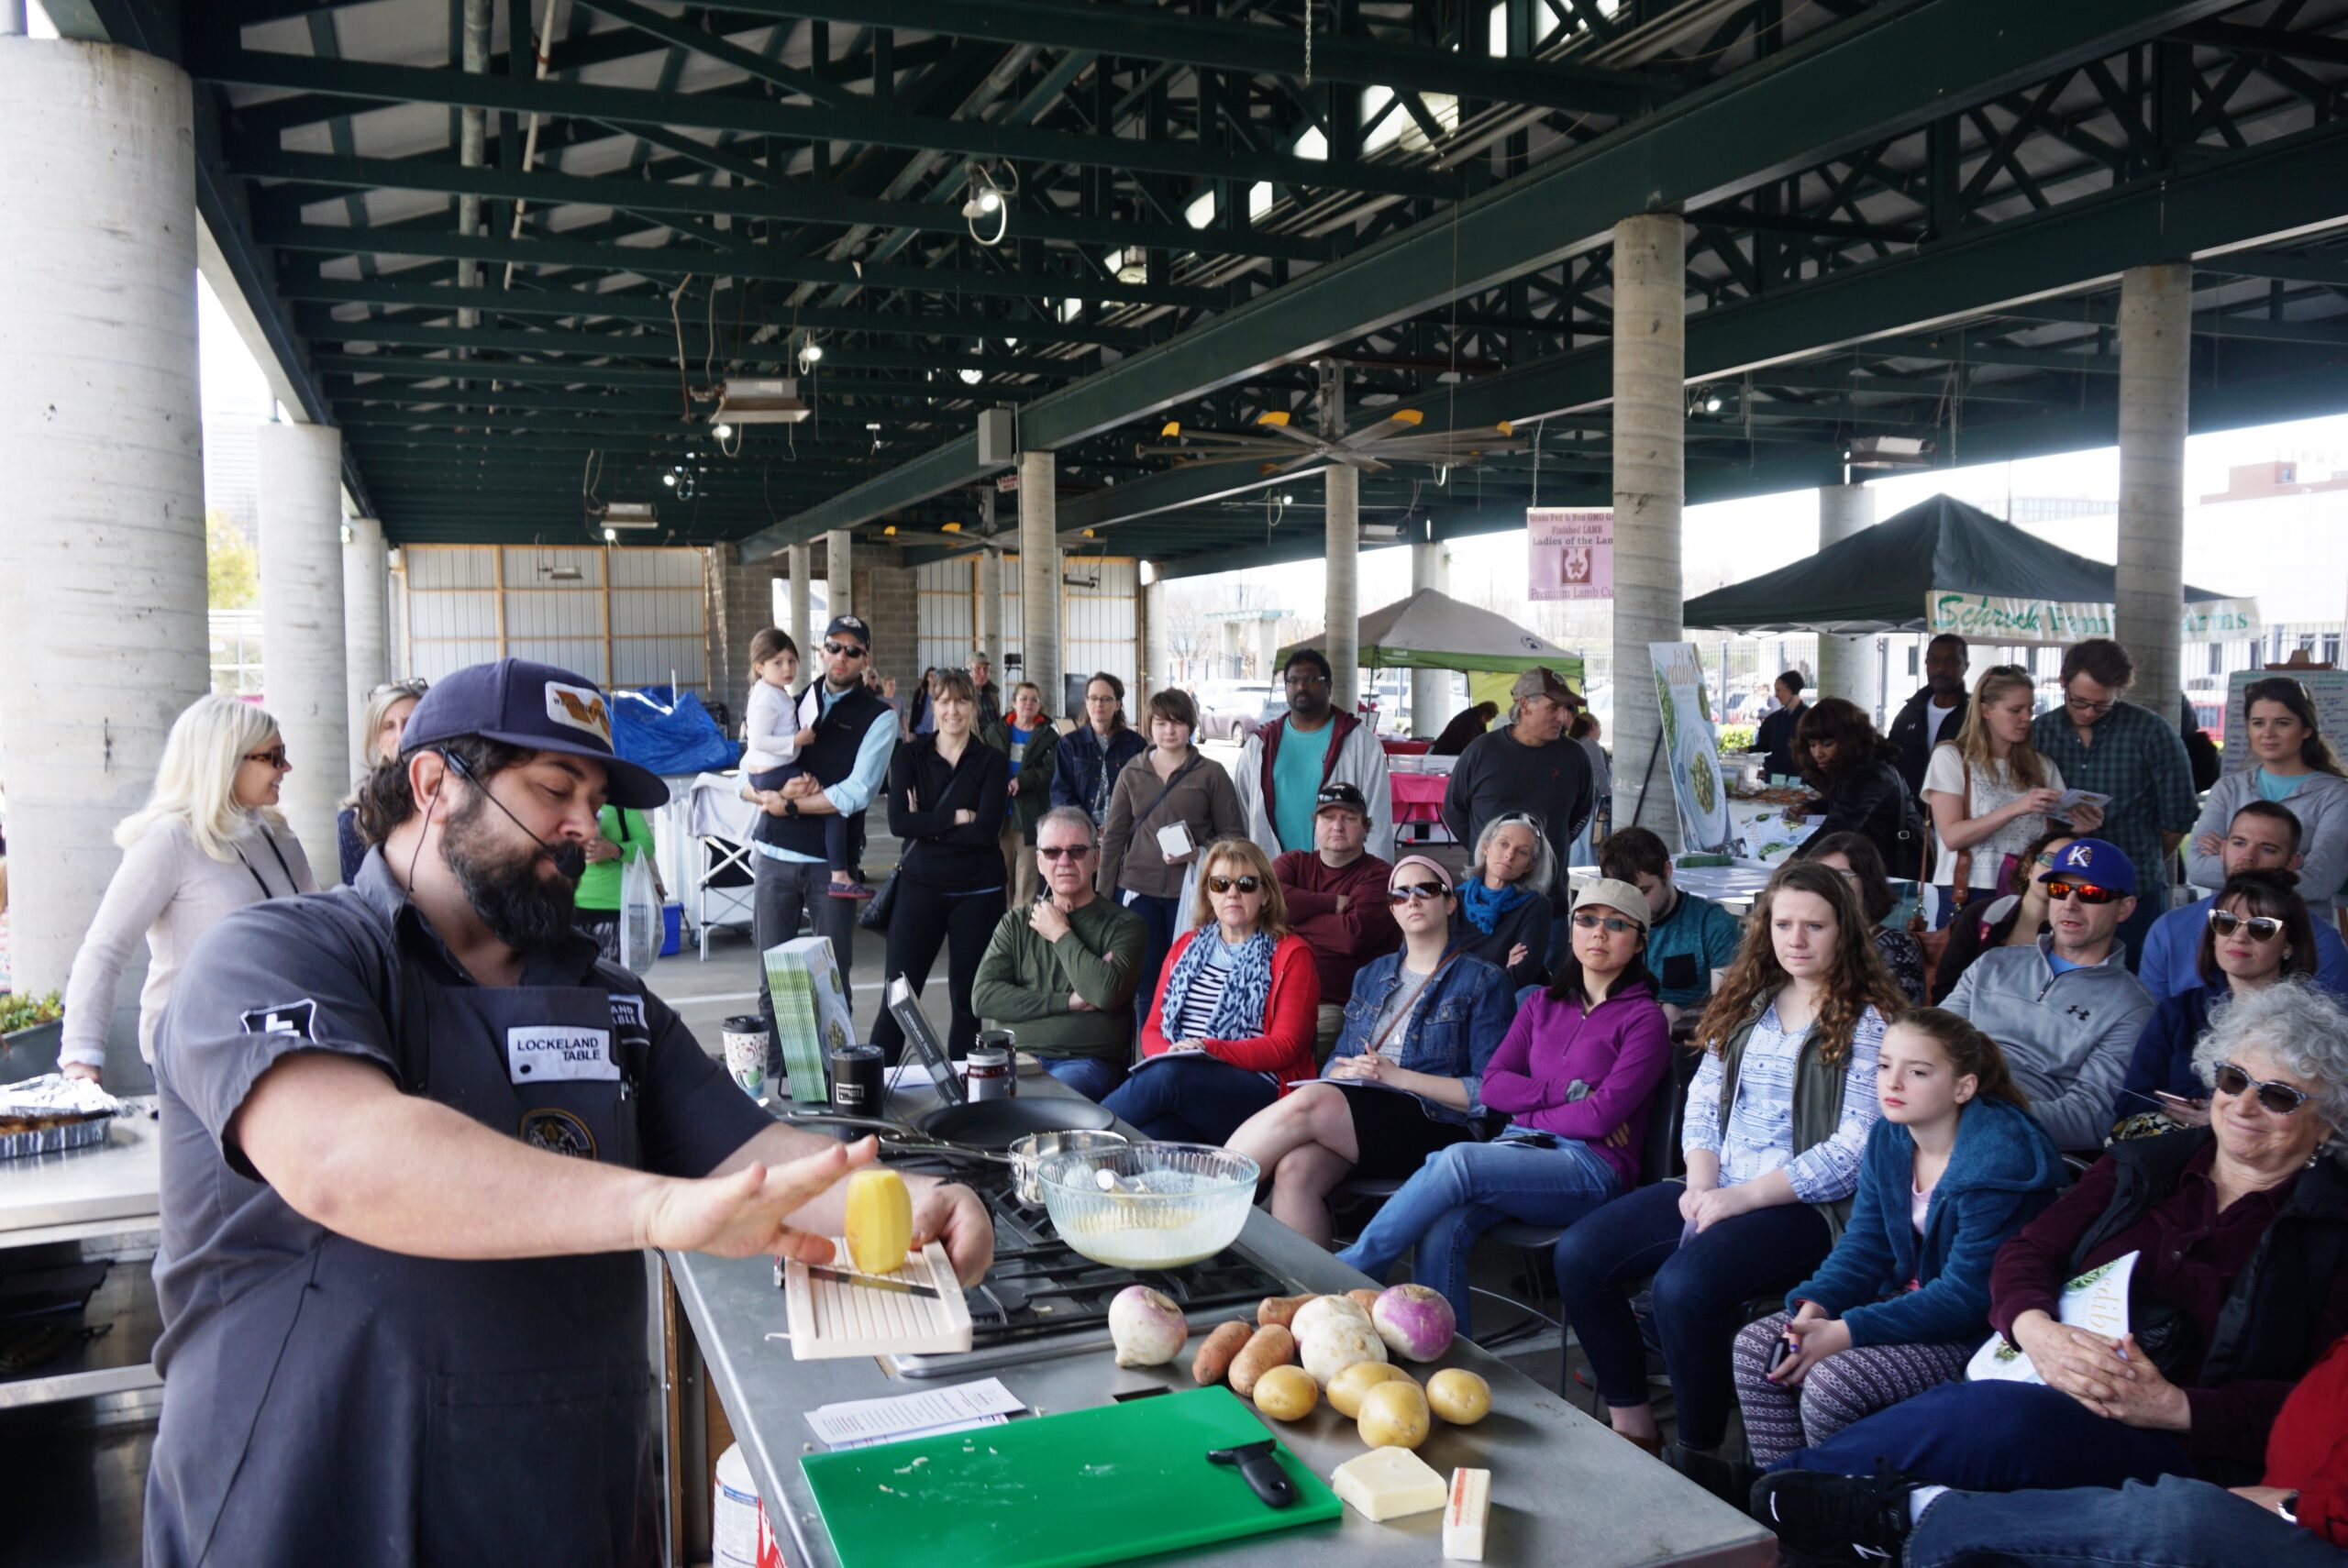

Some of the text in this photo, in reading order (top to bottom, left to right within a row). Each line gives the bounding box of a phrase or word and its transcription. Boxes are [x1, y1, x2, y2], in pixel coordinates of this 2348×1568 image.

[1530, 513, 1549, 522] Grass
[1551, 513, 1563, 522] Fed
[1573, 513, 1586, 522] Non
[1588, 513, 1604, 522] GMO
[1552, 525, 1603, 535] Finished LAMB
[1533, 536, 1562, 546] Ladies
[1565, 536, 1576, 546] of
[1578, 536, 1593, 545] the
[1531, 588, 1570, 599] Premium
[1573, 587, 1599, 598] Lamb
[1933, 595, 2041, 631] Schrock
[517, 1037, 599, 1052] LOCKELAND
[562, 1049, 602, 1062] TABLE
